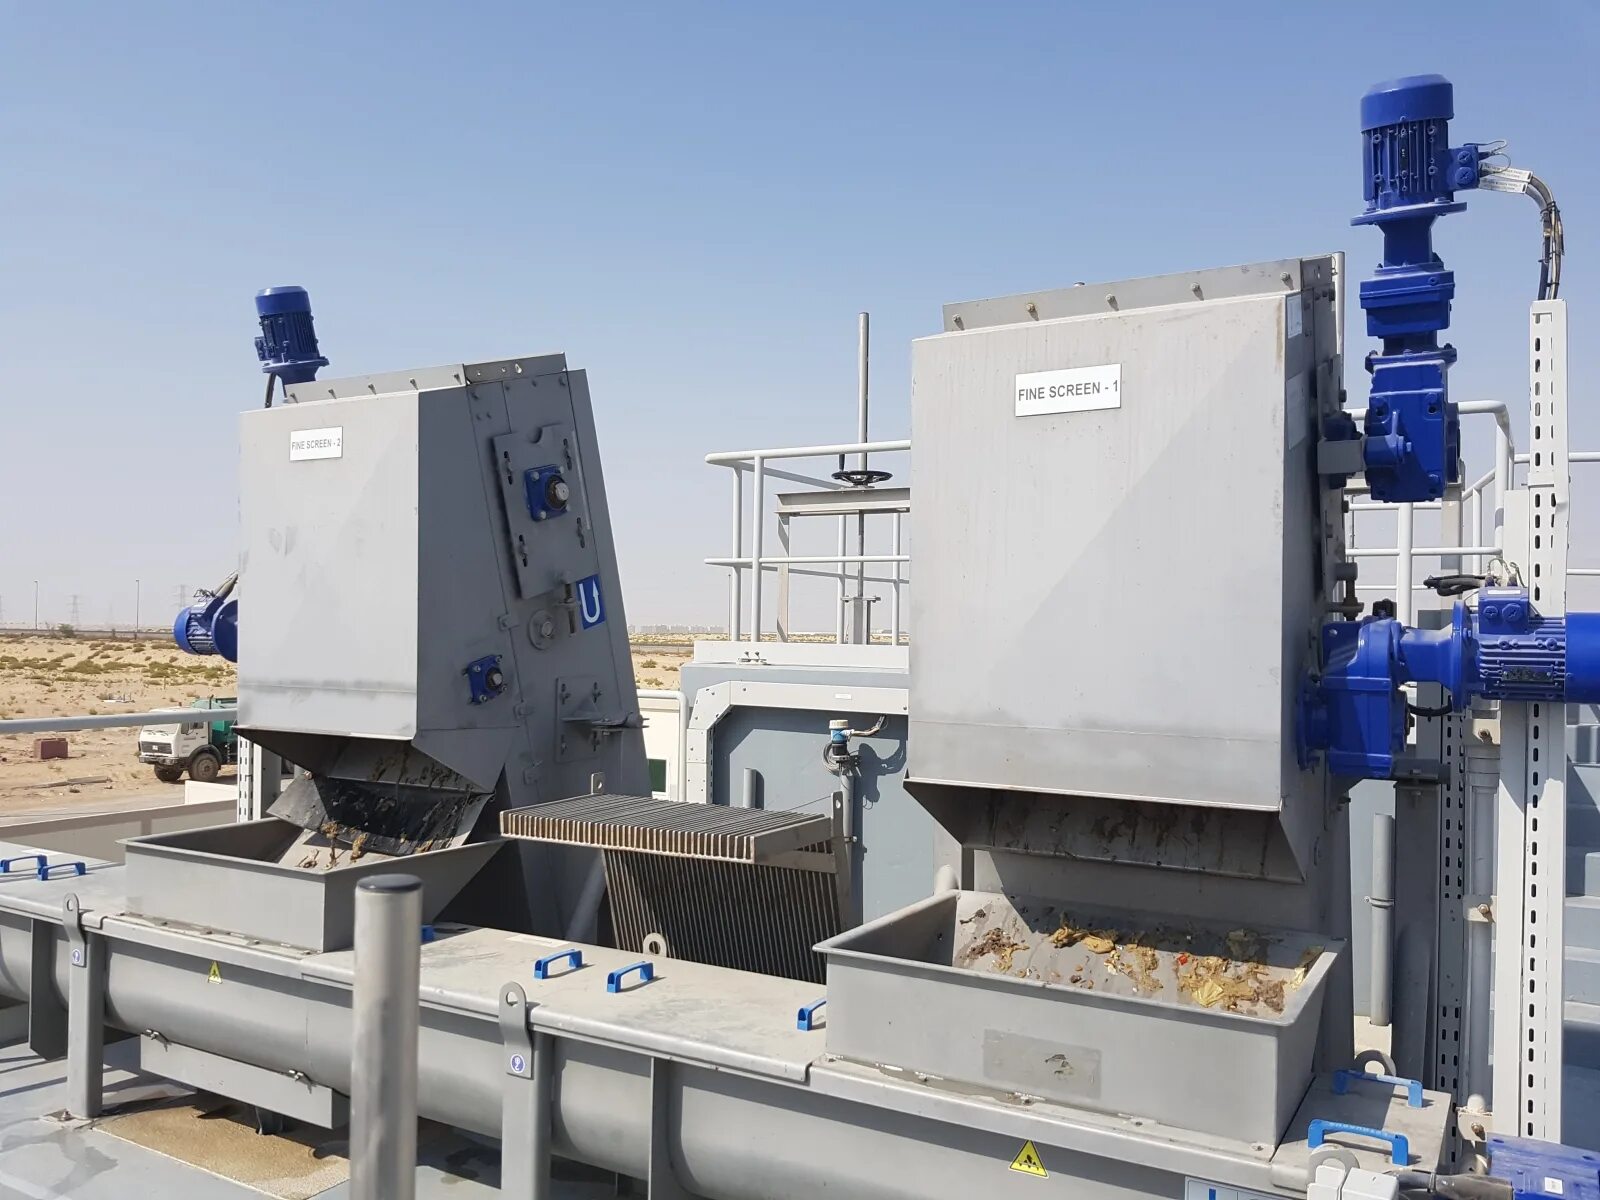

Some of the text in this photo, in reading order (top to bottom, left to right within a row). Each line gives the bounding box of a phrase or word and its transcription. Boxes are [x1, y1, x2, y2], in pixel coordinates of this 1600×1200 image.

[1018, 387, 1045, 401] FINE
[1049, 381, 1101, 398] SCREEN
[1113, 380, 1118, 392] 1
[292, 441, 305, 451] FINE
[306, 438, 332, 449] SCREEN
[337, 437, 341, 447] 2
